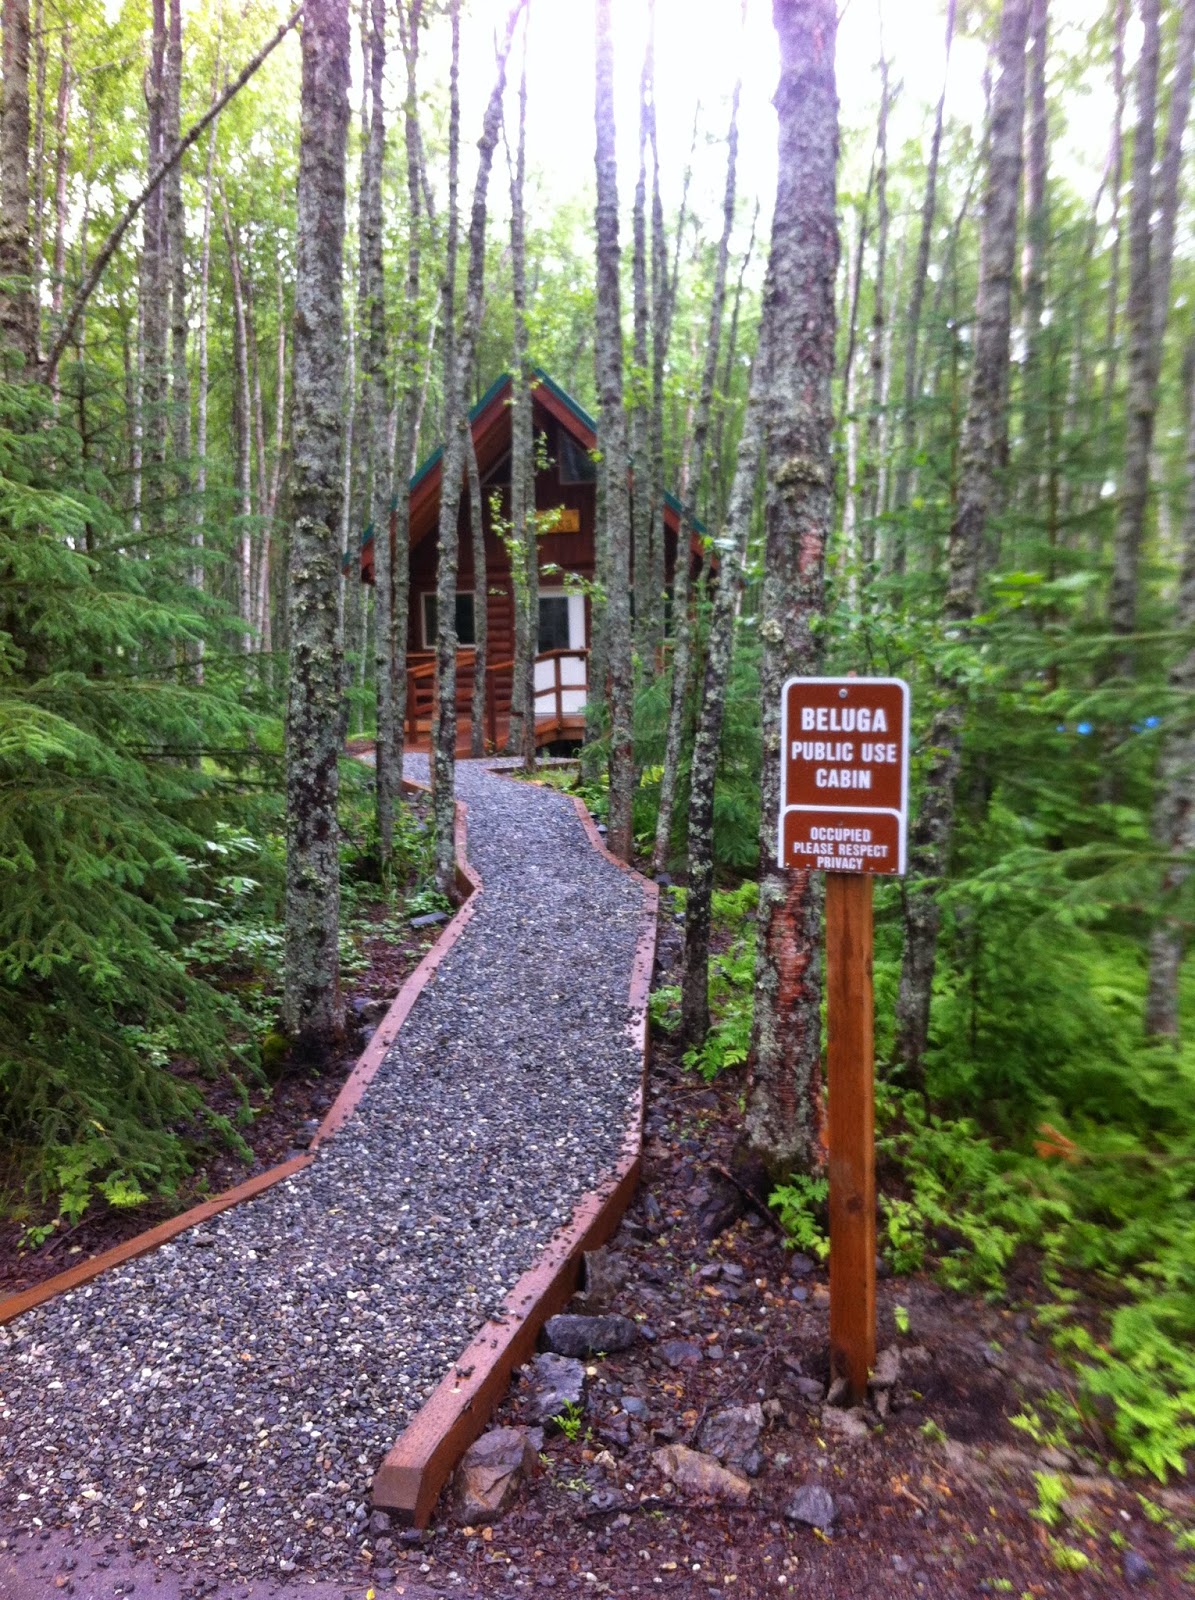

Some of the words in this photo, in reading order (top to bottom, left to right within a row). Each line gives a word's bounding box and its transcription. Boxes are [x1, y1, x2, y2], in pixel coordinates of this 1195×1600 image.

[801, 708, 888, 732] BELUGA
[791, 741, 854, 761] PUBLIC
[861, 743, 897, 763] USE
[815, 768, 871, 789] CABIN
[810, 826, 871, 843] OCCUPIED
[793, 842, 834, 855] PLEASE
[838, 844, 888, 857] RESPECT
[816, 856, 864, 870] PRIVACY
